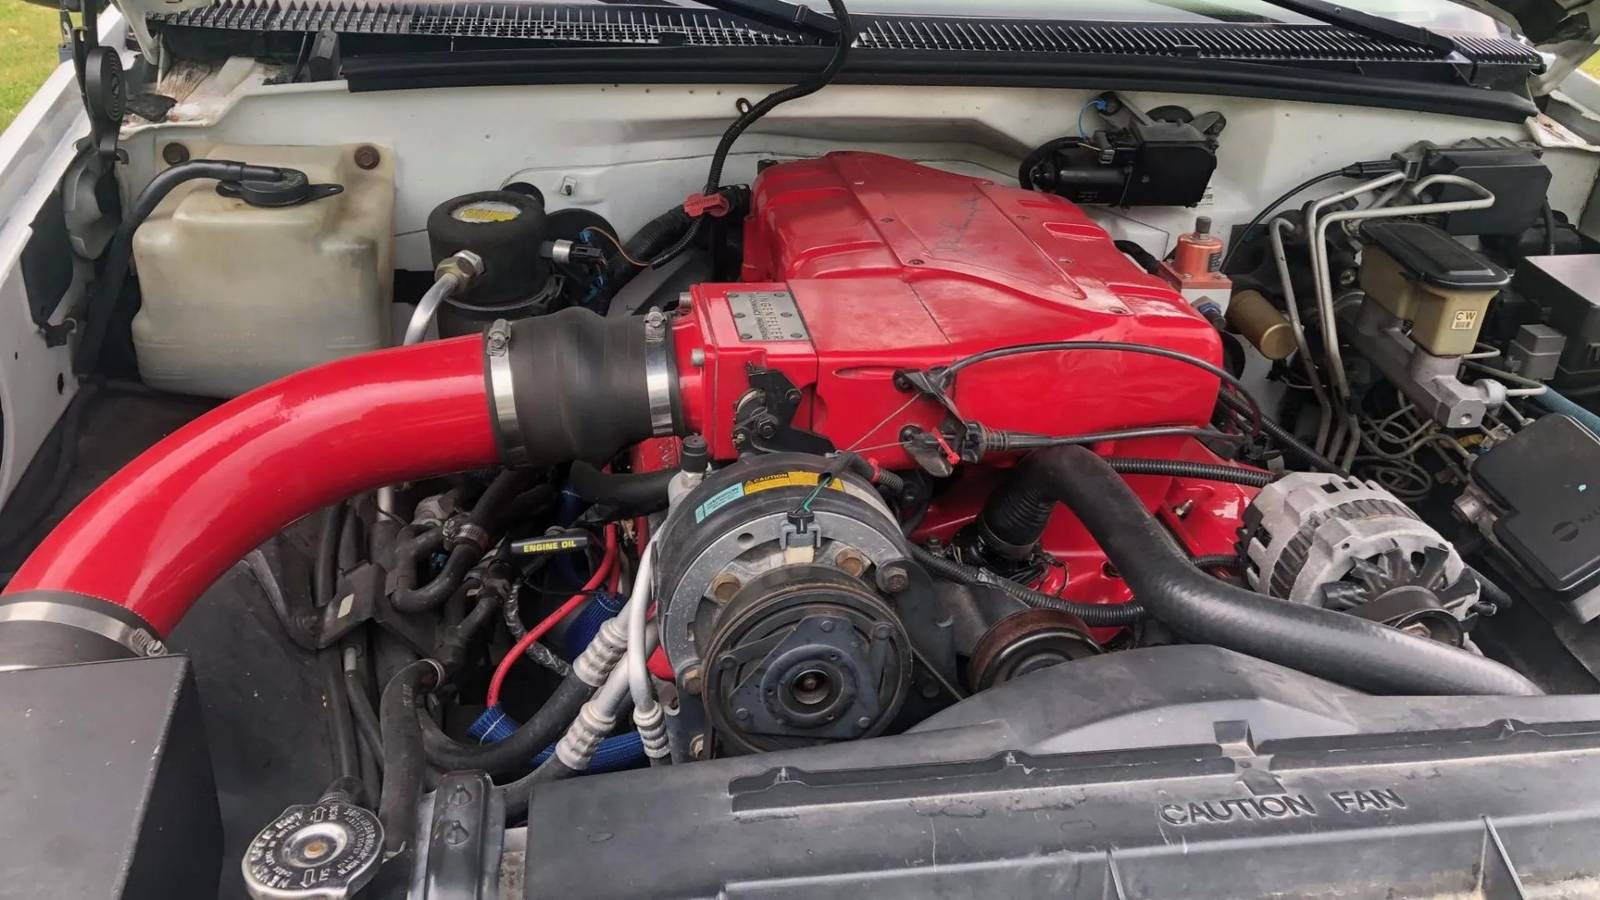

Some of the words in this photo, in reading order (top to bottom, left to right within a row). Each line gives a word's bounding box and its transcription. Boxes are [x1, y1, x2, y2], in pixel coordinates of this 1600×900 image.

[753, 471, 787, 483] CAUTION
[523, 543, 559, 553] ENGINE
[561, 539, 577, 548] OIL
[1160, 794, 1318, 825] CAUTION
[1328, 788, 1406, 812] FAN
